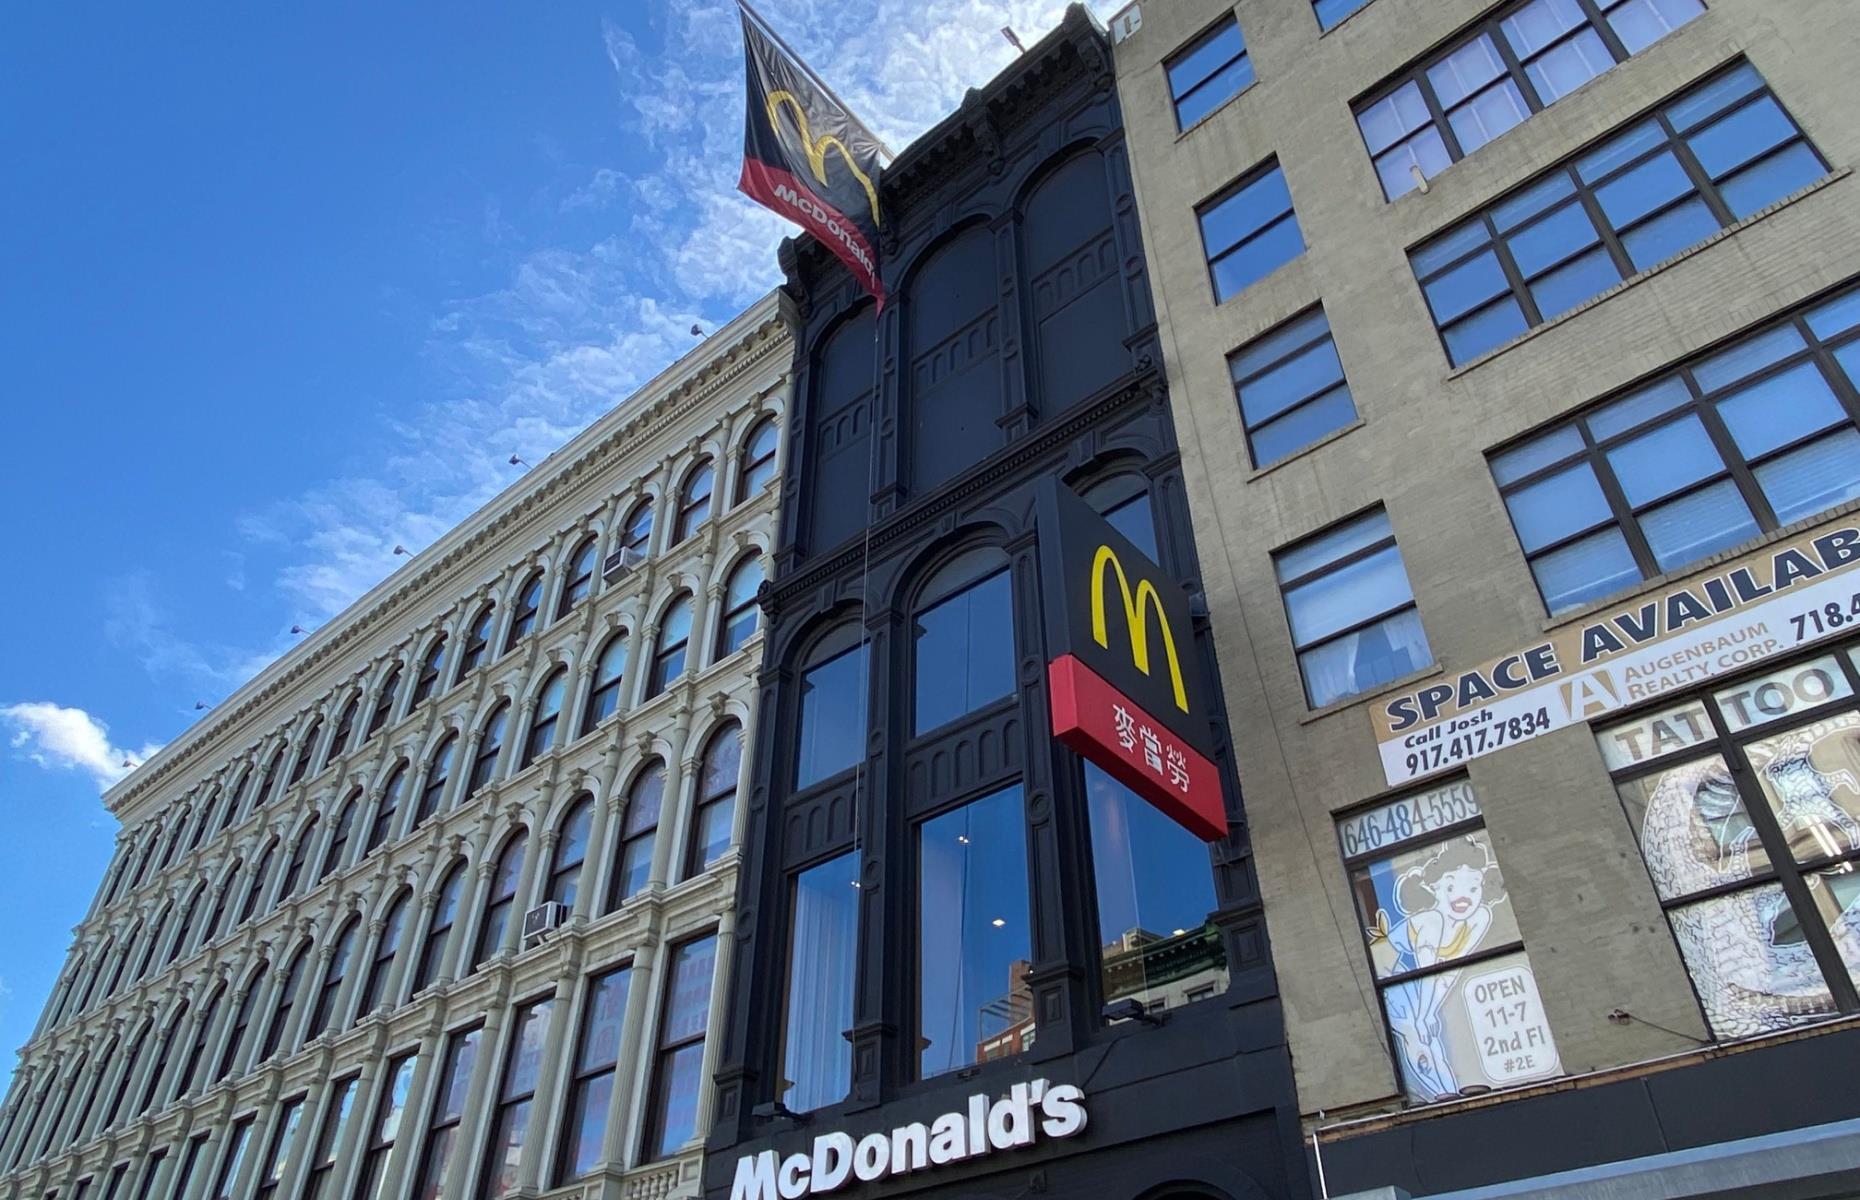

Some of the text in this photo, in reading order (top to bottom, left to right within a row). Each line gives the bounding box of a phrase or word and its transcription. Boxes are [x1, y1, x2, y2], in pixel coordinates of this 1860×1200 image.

[1624, 621, 1770, 684] AUGENBAUM
[1626, 638, 1785, 701] REALTY CORP.
[1386, 642, 1562, 732] SPACE
[1112, 703, 1190, 792] 麥當勞
[1404, 708, 1493, 749] Call Josh
[1406, 706, 1551, 776] 917.417.7834
[1344, 781, 1482, 855] 646-484-5559
[1474, 975, 1526, 1004] OPEN
[1485, 1001, 1527, 1028] 11-7
[1483, 1030, 1522, 1057] 2nd
[1504, 1054, 1536, 1073] #2E
[730, 1078, 1088, 1200] McDonald's
